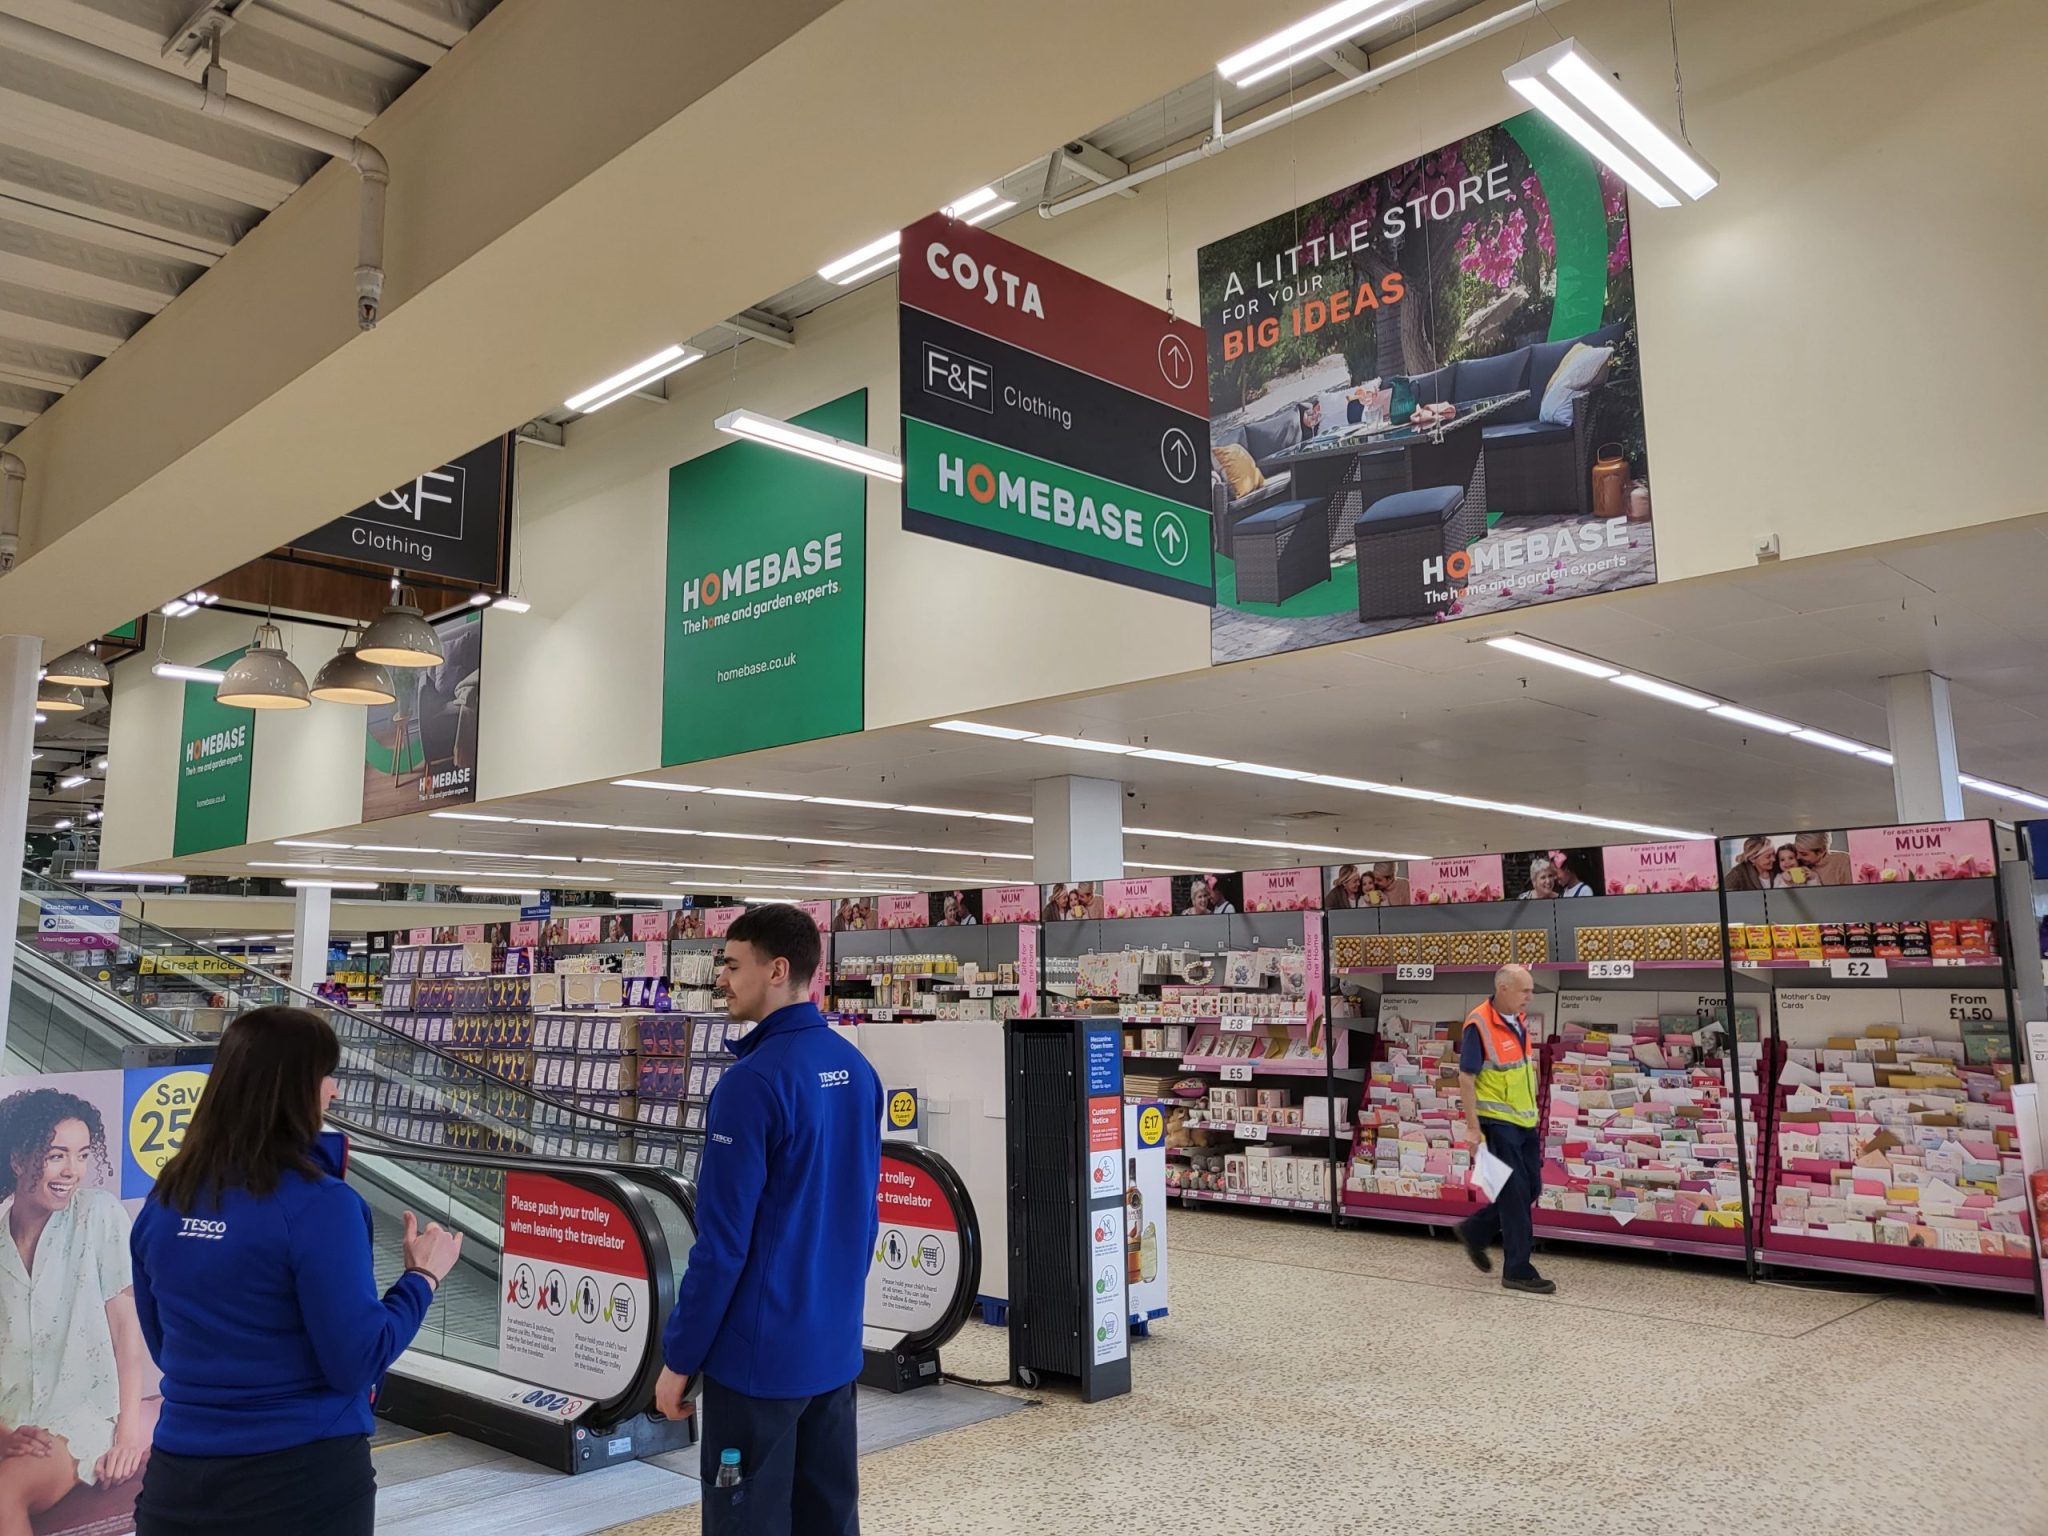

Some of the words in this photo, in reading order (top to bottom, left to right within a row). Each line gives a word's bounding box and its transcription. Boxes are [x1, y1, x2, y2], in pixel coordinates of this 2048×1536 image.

[1223, 272, 1244, 301] A
[1257, 222, 1369, 288] LITTLE
[1383, 163, 1511, 238] STORE
[926, 242, 1045, 320] COSTA
[1223, 299, 1259, 324] FOR
[1269, 275, 1323, 304] YOUR
[1224, 318, 1279, 362] BIG
[1293, 273, 1405, 337] IDEAS
[928, 351, 988, 399] F&F
[1004, 386, 1071, 430] Clothing
[938, 453, 1144, 547] HOMEBASE
[352, 528, 432, 561] Clothing
[1423, 516, 1628, 585] HOMEBASE
[682, 532, 842, 612] HOMEBASE
[1425, 590, 1448, 604] The
[1450, 583, 1486, 599] home
[1489, 575, 1515, 591] and
[1518, 567, 1567, 588] garden
[1572, 554, 1626, 576] experts
[683, 620, 700, 635] The
[702, 613, 729, 630] home
[732, 603, 751, 621] and
[754, 594, 792, 619] garden
[717, 652, 796, 683] homebase.co.uk
[187, 725, 245, 762] HOMEBASE
[419, 768, 470, 791] HOMEBASE
[1896, 835, 1941, 850] MUM
[1640, 852, 1676, 865] MUM
[1440, 865, 1469, 878] MUM
[1126, 885, 1147, 895] MUM
[1269, 878, 1294, 888] MUM
[542, 891, 550, 902] 38
[685, 895, 694, 906] 37
[1001, 893, 1020, 903] MUM
[895, 901, 911, 910] MUM
[161, 959, 199, 970] Great
[203, 959, 241, 970] Prices
[1591, 964, 1631, 977] £5.99
[1848, 962, 1871, 976] £2
[1399, 967, 1432, 978] £5.99
[977, 987, 985, 996] £7
[1699, 997, 1728, 1006] From
[1951, 994, 1987, 1004] From
[878, 1011, 886, 1019] £5
[1950, 1008, 1992, 1020] £1.50
[1230, 1019, 1243, 1029] £8
[818, 1070, 849, 1084] TESCO
[1230, 1068, 1243, 1079] £5
[156, 1083, 202, 1106] Sav
[894, 1099, 912, 1112] £22
[1092, 1108, 1117, 1116] Customer
[1145, 1115, 1158, 1129] £17
[139, 1108, 193, 1153] 25
[712, 1133, 733, 1144] TESCO
[886, 1172, 915, 1188] trolley
[885, 1192, 932, 1208] travelator
[511, 1195, 536, 1212] Please
[538, 1201, 558, 1216] push
[560, 1206, 579, 1219] your
[582, 1207, 609, 1227] trolley
[181, 1217, 226, 1233] TESCO
[511, 1219, 532, 1234] when
[534, 1222, 562, 1243] leaving
[565, 1226, 579, 1242] the
[581, 1231, 625, 1250] travelator
